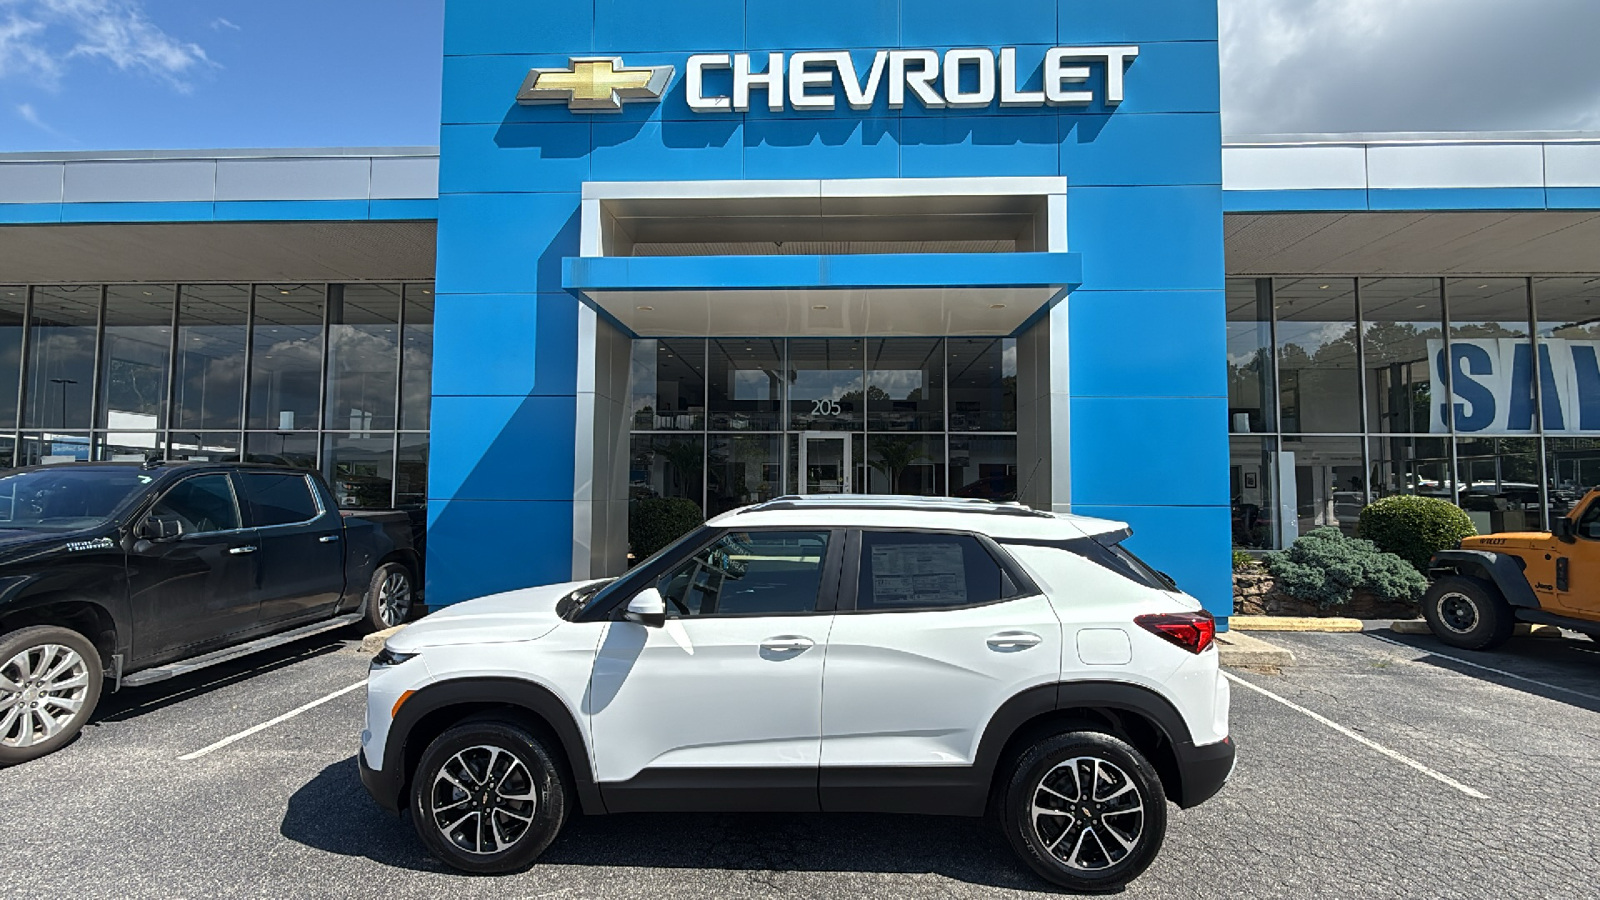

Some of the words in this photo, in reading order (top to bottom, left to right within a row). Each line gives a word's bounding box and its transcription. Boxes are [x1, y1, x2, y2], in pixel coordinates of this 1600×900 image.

[686, 46, 1140, 112] CHEVROLET
[811, 399, 841, 416] 205
[1534, 581, 1553, 591] Jeep
